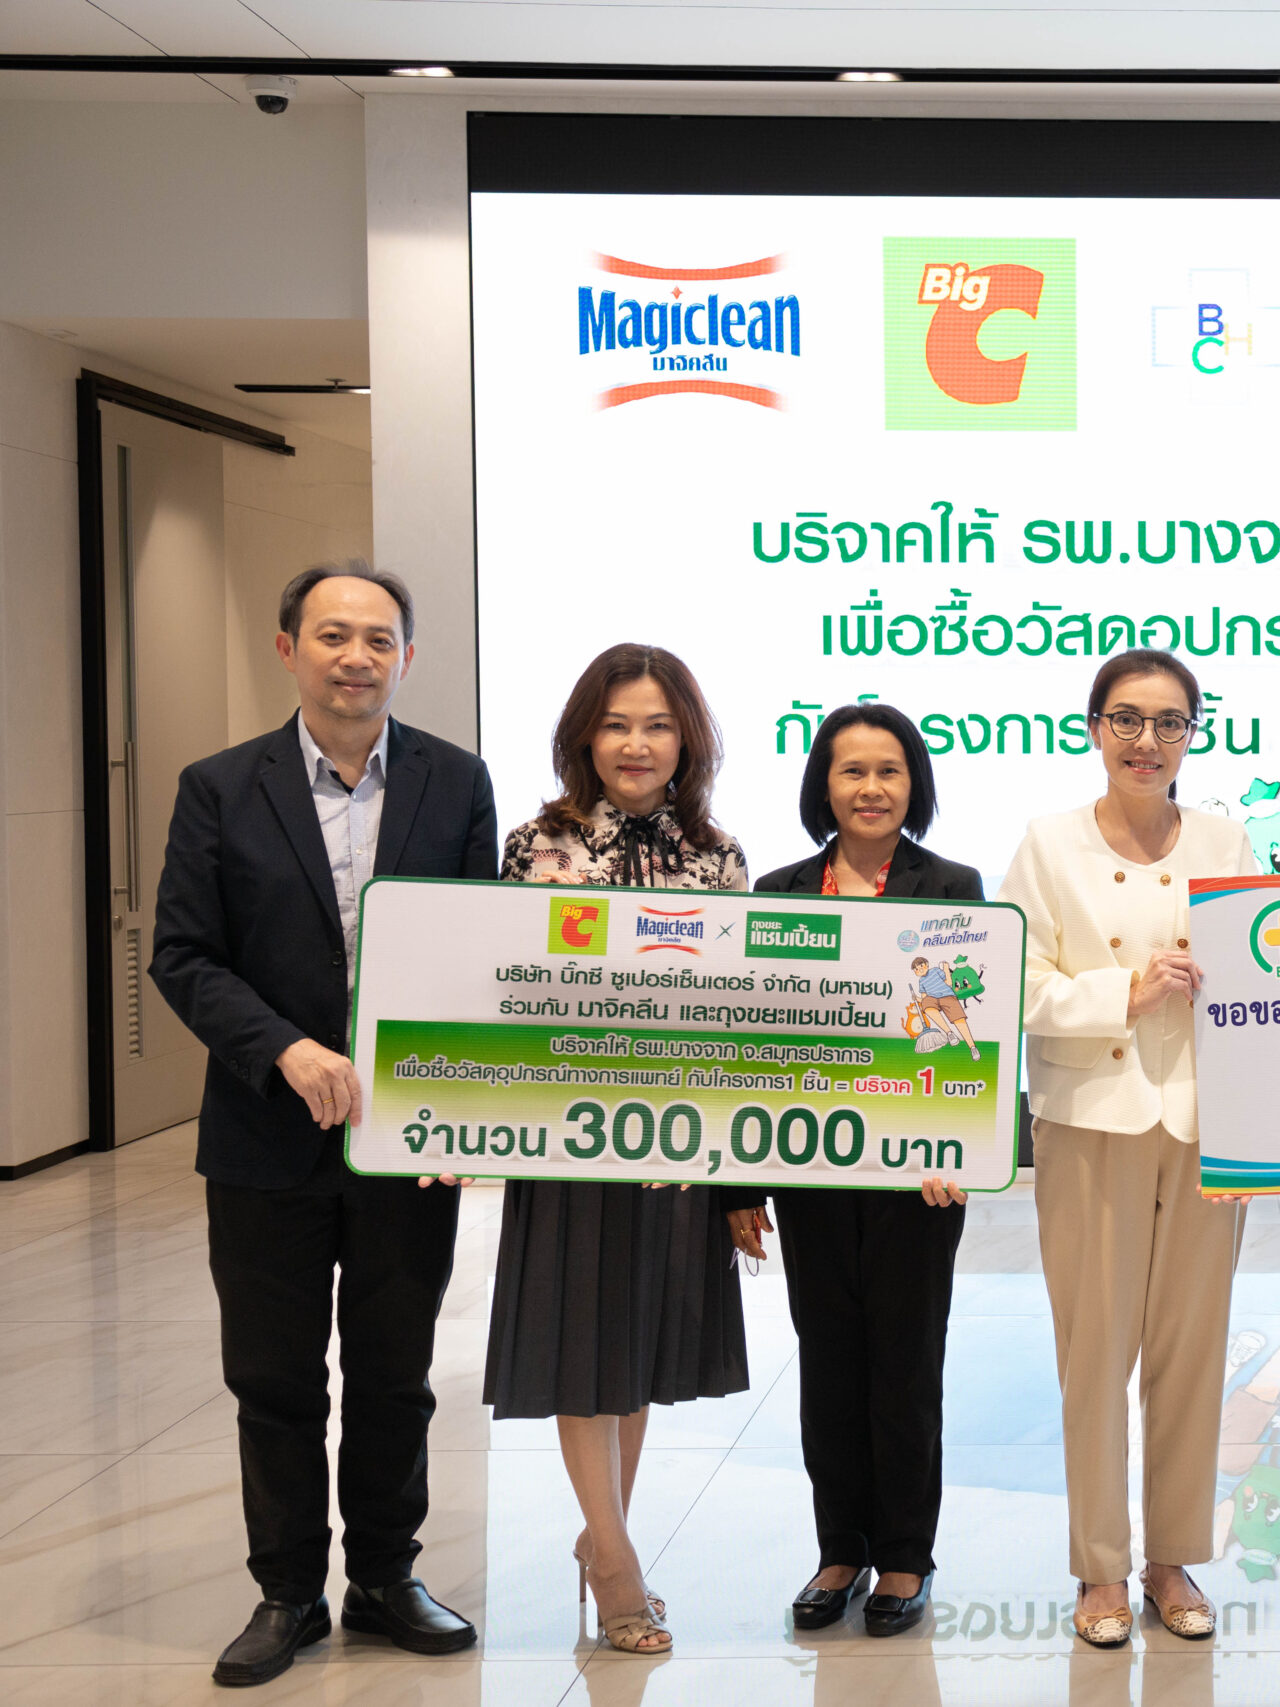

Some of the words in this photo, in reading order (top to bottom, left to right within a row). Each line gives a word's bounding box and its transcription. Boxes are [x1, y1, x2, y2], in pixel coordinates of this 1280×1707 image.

[921, 262, 989, 311] Big
[578, 286, 800, 356] Magiclean
[752, 500, 1000, 564] บริจาคให้
[561, 905, 582, 919] Big
[636, 915, 704, 939] Magiclean
[751, 919, 783, 932] ถุงขยะ
[919, 912, 973, 932] แทคทีม
[750, 923, 837, 949] แชมเปี้ยน
[496, 964, 552, 984] บริษัท
[560, 961, 602, 985] บิ๊กซี
[611, 967, 756, 992] ซูเปอร์เซ็นเตอร์
[763, 973, 811, 994] จำกัด
[819, 977, 893, 1001] (มหาชน)
[499, 994, 569, 1016] ร่วมกับ
[577, 998, 669, 1021] มาจิคลีน
[680, 1001, 887, 1028] และถุงขยะแชมเปี้ยน
[551, 1034, 629, 1056] บริจาคให้
[635, 1040, 737, 1059] รพ.บางจาก
[743, 1044, 873, 1066] จ.สมุทรปราการ
[395, 1055, 681, 1086] เพื่อซื้อวัสดุอุปกรณ์ทางการแพทย์
[803, 1070, 829, 1093] ชิ้น
[837, 1081, 849, 1092] =
[854, 1075, 911, 1095] บริจาค
[917, 1067, 934, 1095] 1
[402, 1107, 548, 1158] จำนวน
[563, 1100, 866, 1176] 300,000
[880, 1136, 963, 1171] บาท
